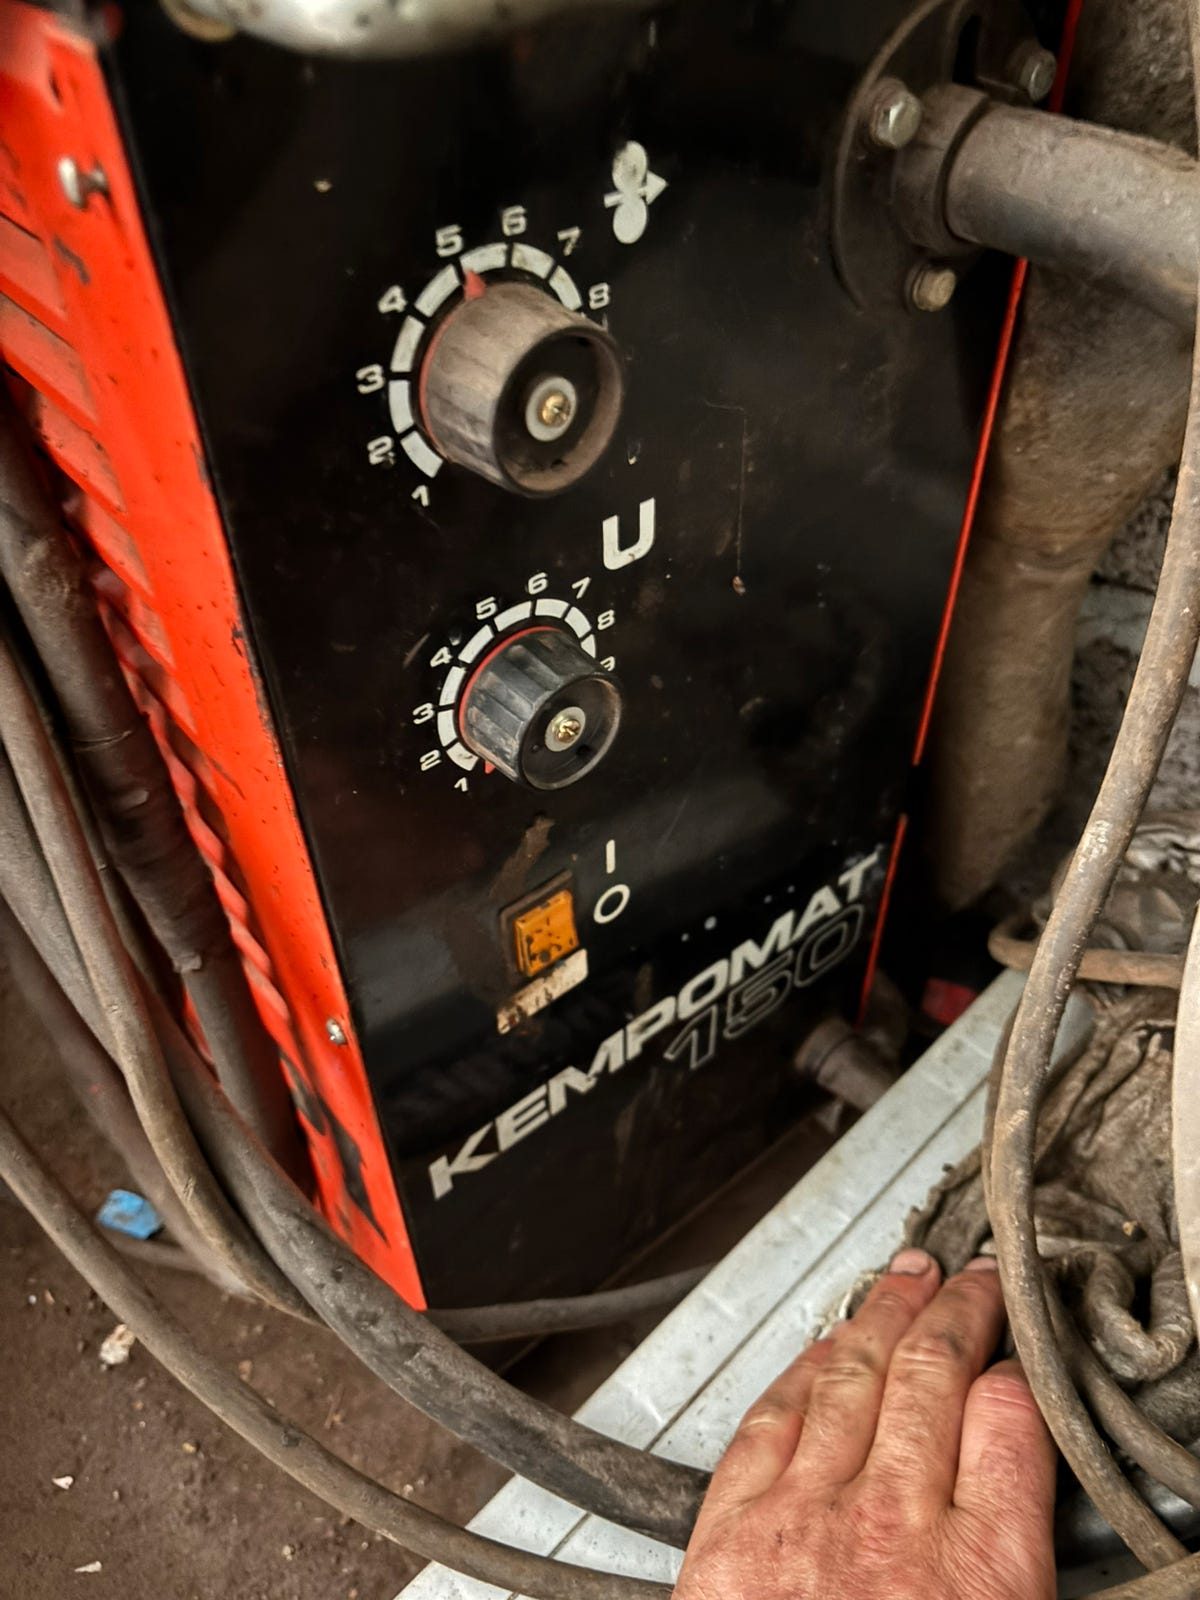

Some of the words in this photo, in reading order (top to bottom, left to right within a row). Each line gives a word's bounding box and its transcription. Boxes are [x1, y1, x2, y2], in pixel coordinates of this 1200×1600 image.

[502, 205, 527, 237] 6
[435, 224, 463, 257] 5
[557, 226, 581, 256] 7
[377, 285, 407, 314] 4
[588, 282, 610, 310] 8
[356, 364, 384, 394] 3
[367, 435, 393, 466] 2
[411, 484, 429, 507] 1
[602, 497, 656, 570] U
[527, 572, 548, 595] 6
[571, 576, 591, 599] 7
[475, 596, 497, 620] 5
[597, 609, 616, 631] 8
[429, 646, 454, 668] 4
[412, 702, 435, 725] 3
[419, 749, 441, 772] 2
[454, 777, 468, 792] 1
[664, 903, 863, 1070] 150
[428, 852, 879, 1200] KEMPOMAT
